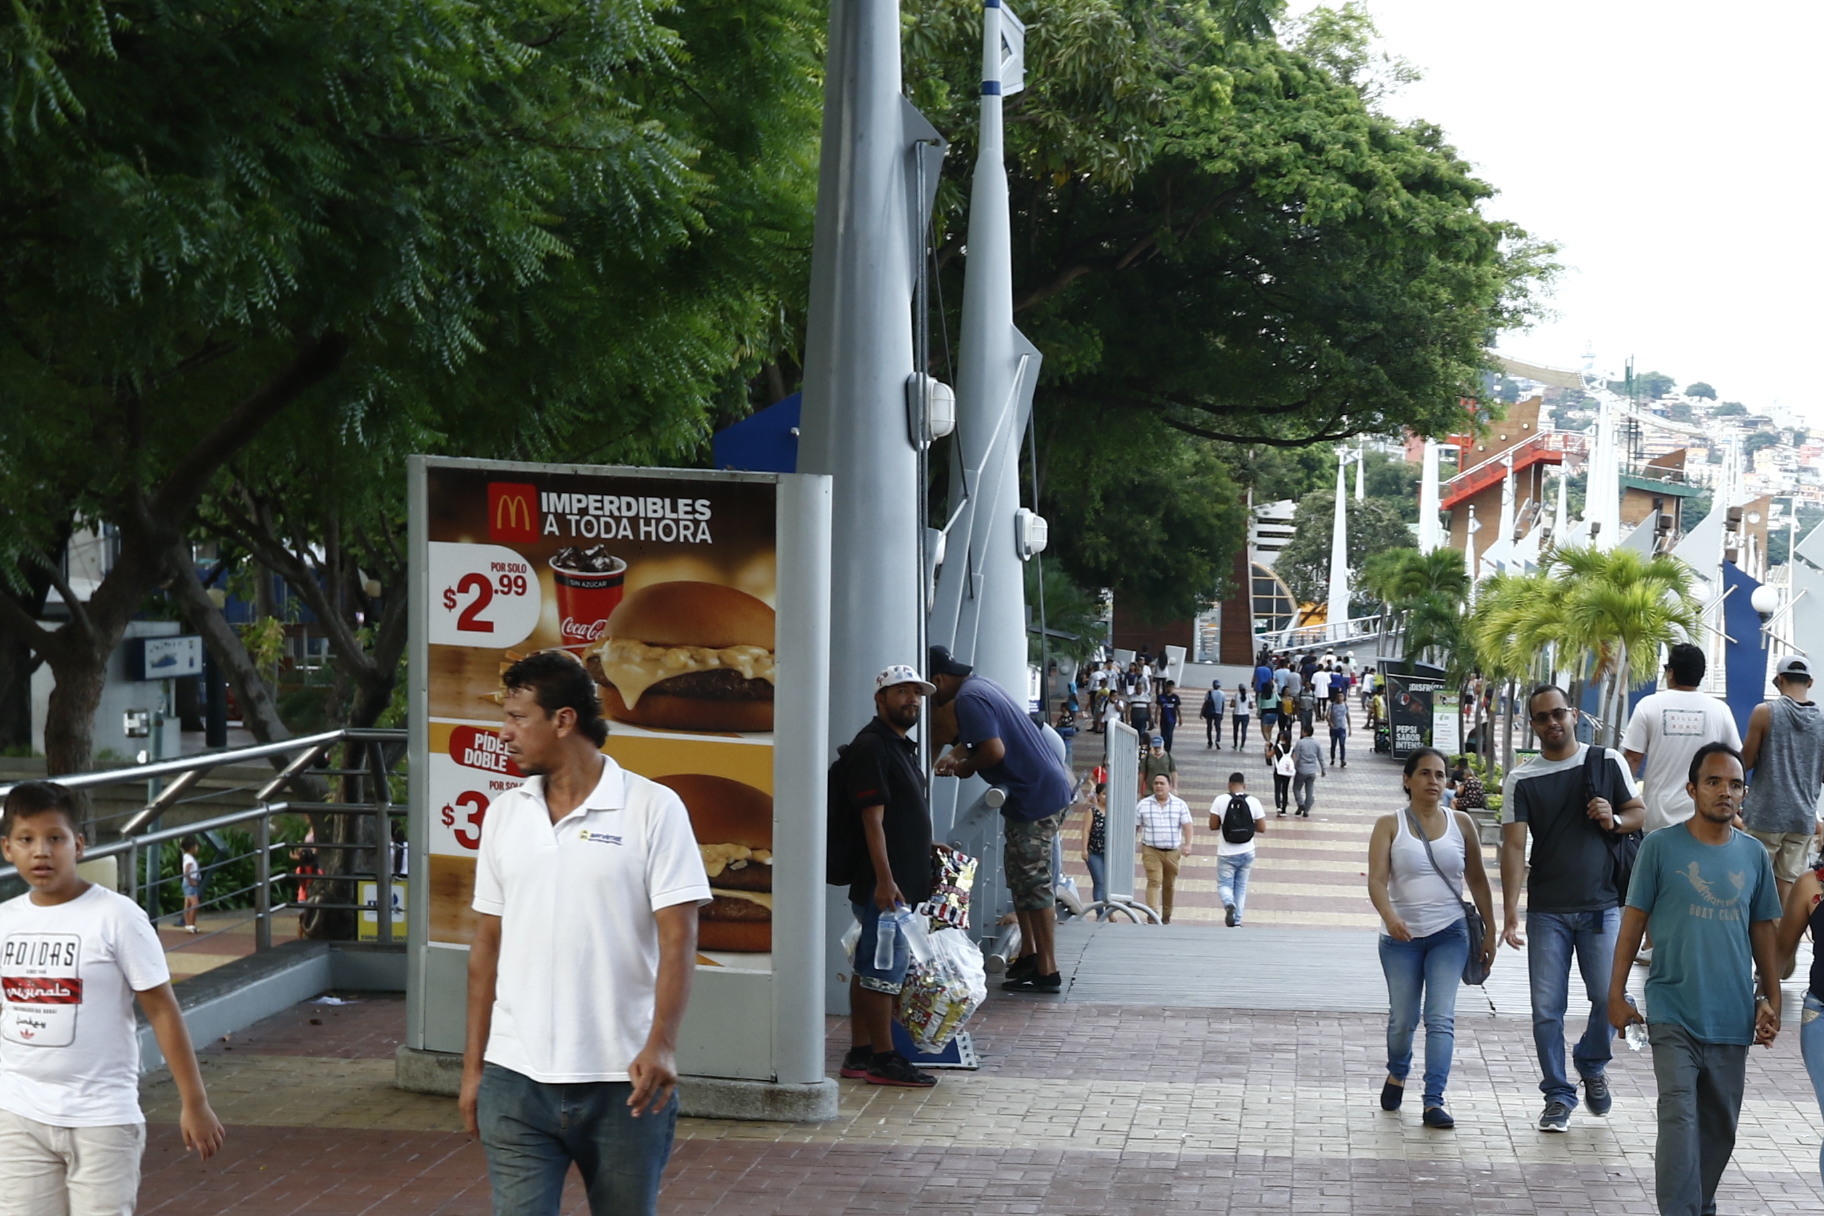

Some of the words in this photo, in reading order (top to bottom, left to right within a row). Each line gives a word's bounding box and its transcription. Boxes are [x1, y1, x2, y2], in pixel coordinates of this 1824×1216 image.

[541, 491, 712, 521] IMPERDIBLES
[543, 513, 560, 536] A
[566, 514, 634, 540] TODA
[639, 518, 713, 544] HORA
[491, 562, 506, 572] POR
[507, 563, 527, 574] SOLO
[1395, 725, 1417, 734] PEPSI
[1395, 733, 1420, 742] SABOR
[474, 731, 512, 756] PÍDEL
[1395, 741, 1424, 750] INTENS
[464, 748, 507, 772] DOBLE
[489, 780, 505, 791] POR
[1689, 903, 1714, 920] BOAT
[3, 942, 76, 966] ADIDAS
